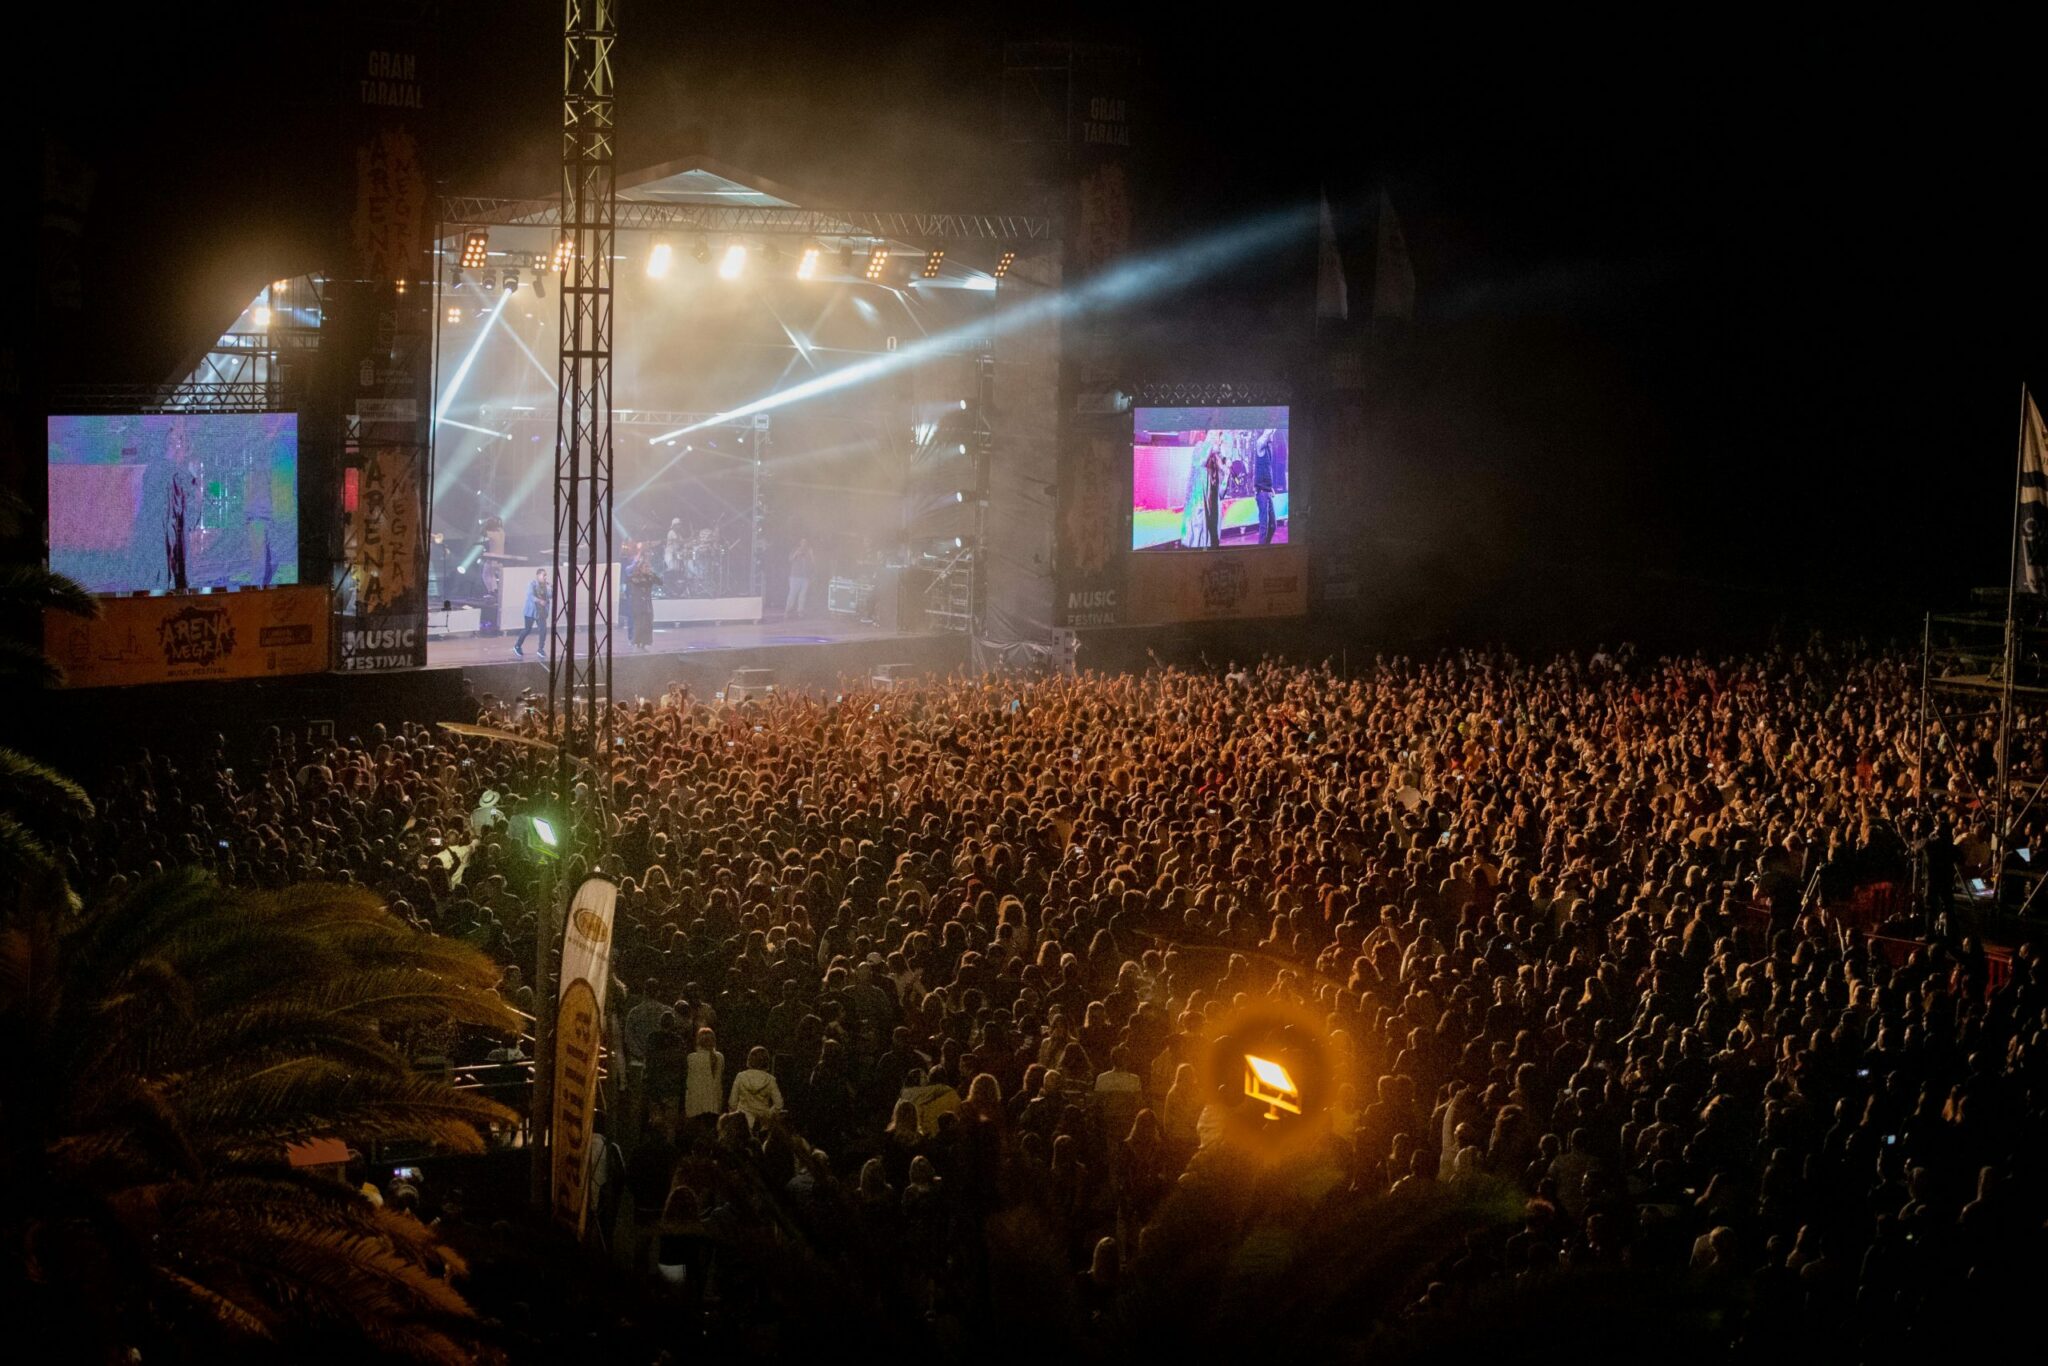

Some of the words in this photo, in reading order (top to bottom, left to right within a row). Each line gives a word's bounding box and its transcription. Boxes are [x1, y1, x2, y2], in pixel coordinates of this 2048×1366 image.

[368, 49, 416, 80] GRAN
[360, 79, 424, 110] TARAJAL
[1090, 96, 1126, 121] GRAN
[1083, 121, 1129, 147] TARAJAL
[364, 459, 386, 602] ARENA
[389, 477, 408, 580] NEGRA
[1067, 590, 1117, 609] MUSIC
[1067, 612, 1115, 626] FESTIVAL
[161, 612, 234, 652] ARENA
[342, 629, 416, 649] MUSIC
[169, 638, 226, 661] NEGRA
[342, 654, 415, 671] FESTIVAL
